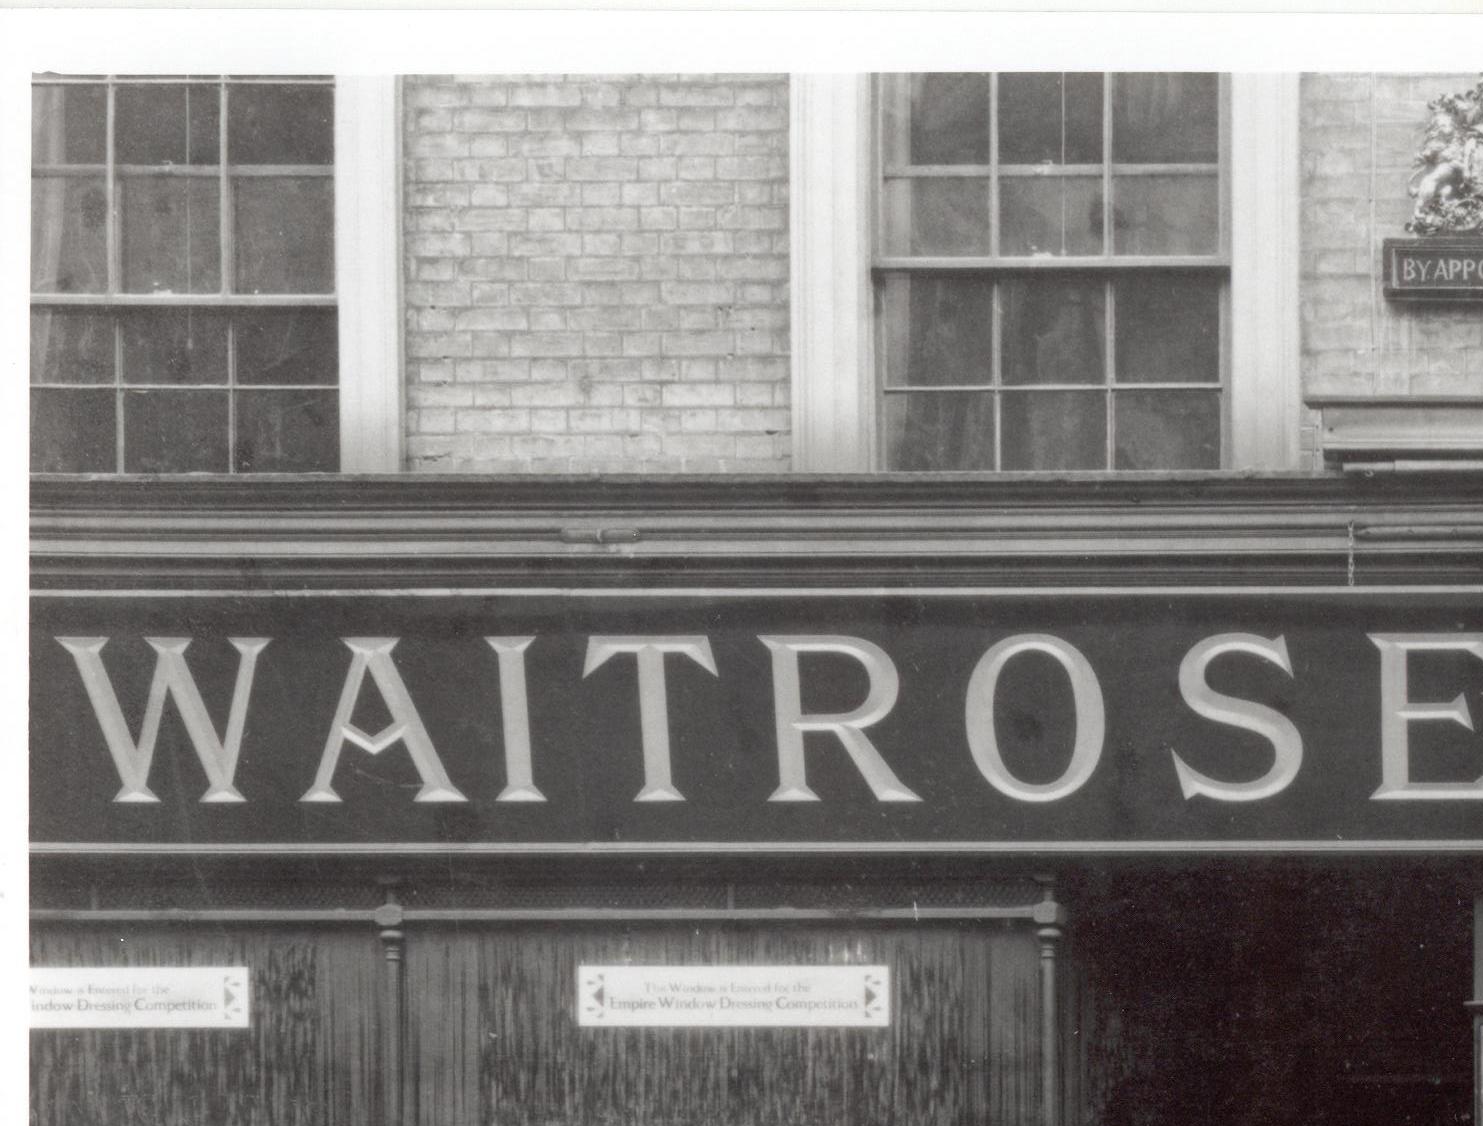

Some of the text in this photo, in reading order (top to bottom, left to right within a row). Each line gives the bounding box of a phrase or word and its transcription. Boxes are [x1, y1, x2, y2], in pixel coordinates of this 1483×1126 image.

[1403, 258, 1431, 282] BY
[669, 982, 716, 994] Window
[793, 981, 811, 993] the
[31, 998, 217, 1014] indow Dressing Competition
[609, 996, 858, 1012] Empire Window Dressing Competition
